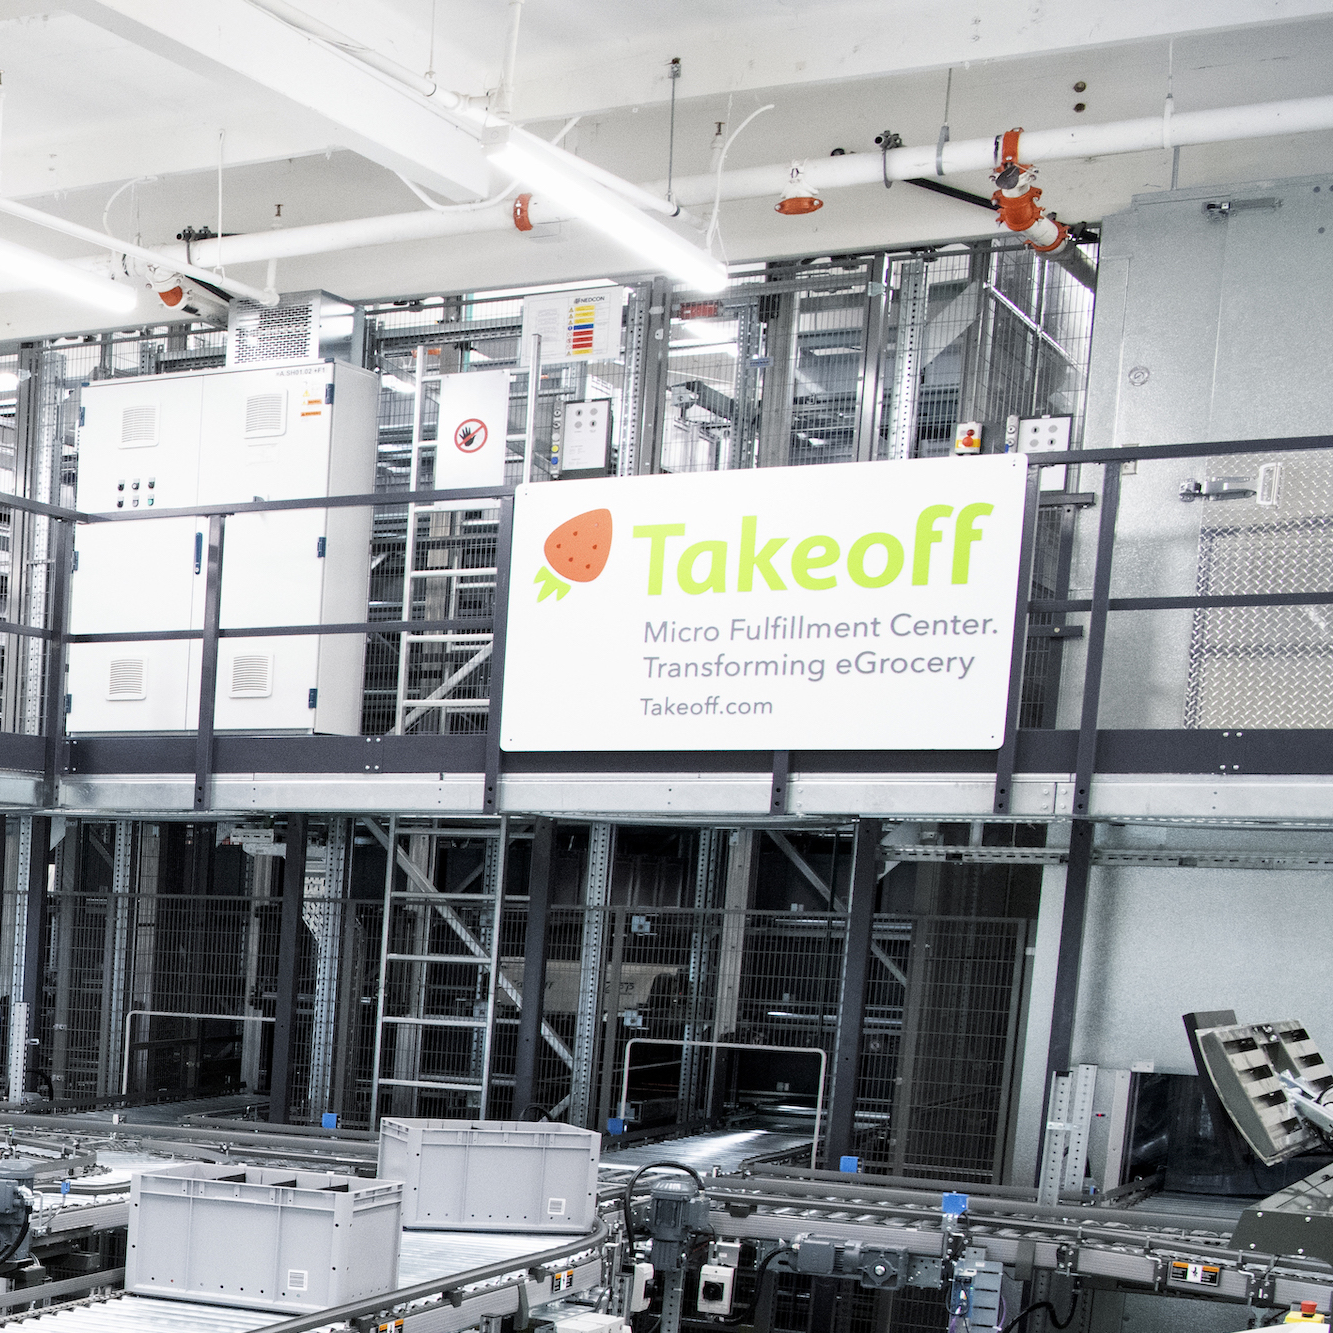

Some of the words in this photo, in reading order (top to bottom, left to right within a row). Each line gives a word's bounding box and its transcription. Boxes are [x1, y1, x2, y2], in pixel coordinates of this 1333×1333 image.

[632, 502, 995, 596] Takeoff
[643, 621, 720, 643] Micro
[730, 615, 881, 642] Fulfillment
[890, 613, 998, 638] Center.
[643, 653, 825, 682] Transforming
[836, 651, 975, 679] eGrocery
[640, 695, 773, 716] Takeoff.com
